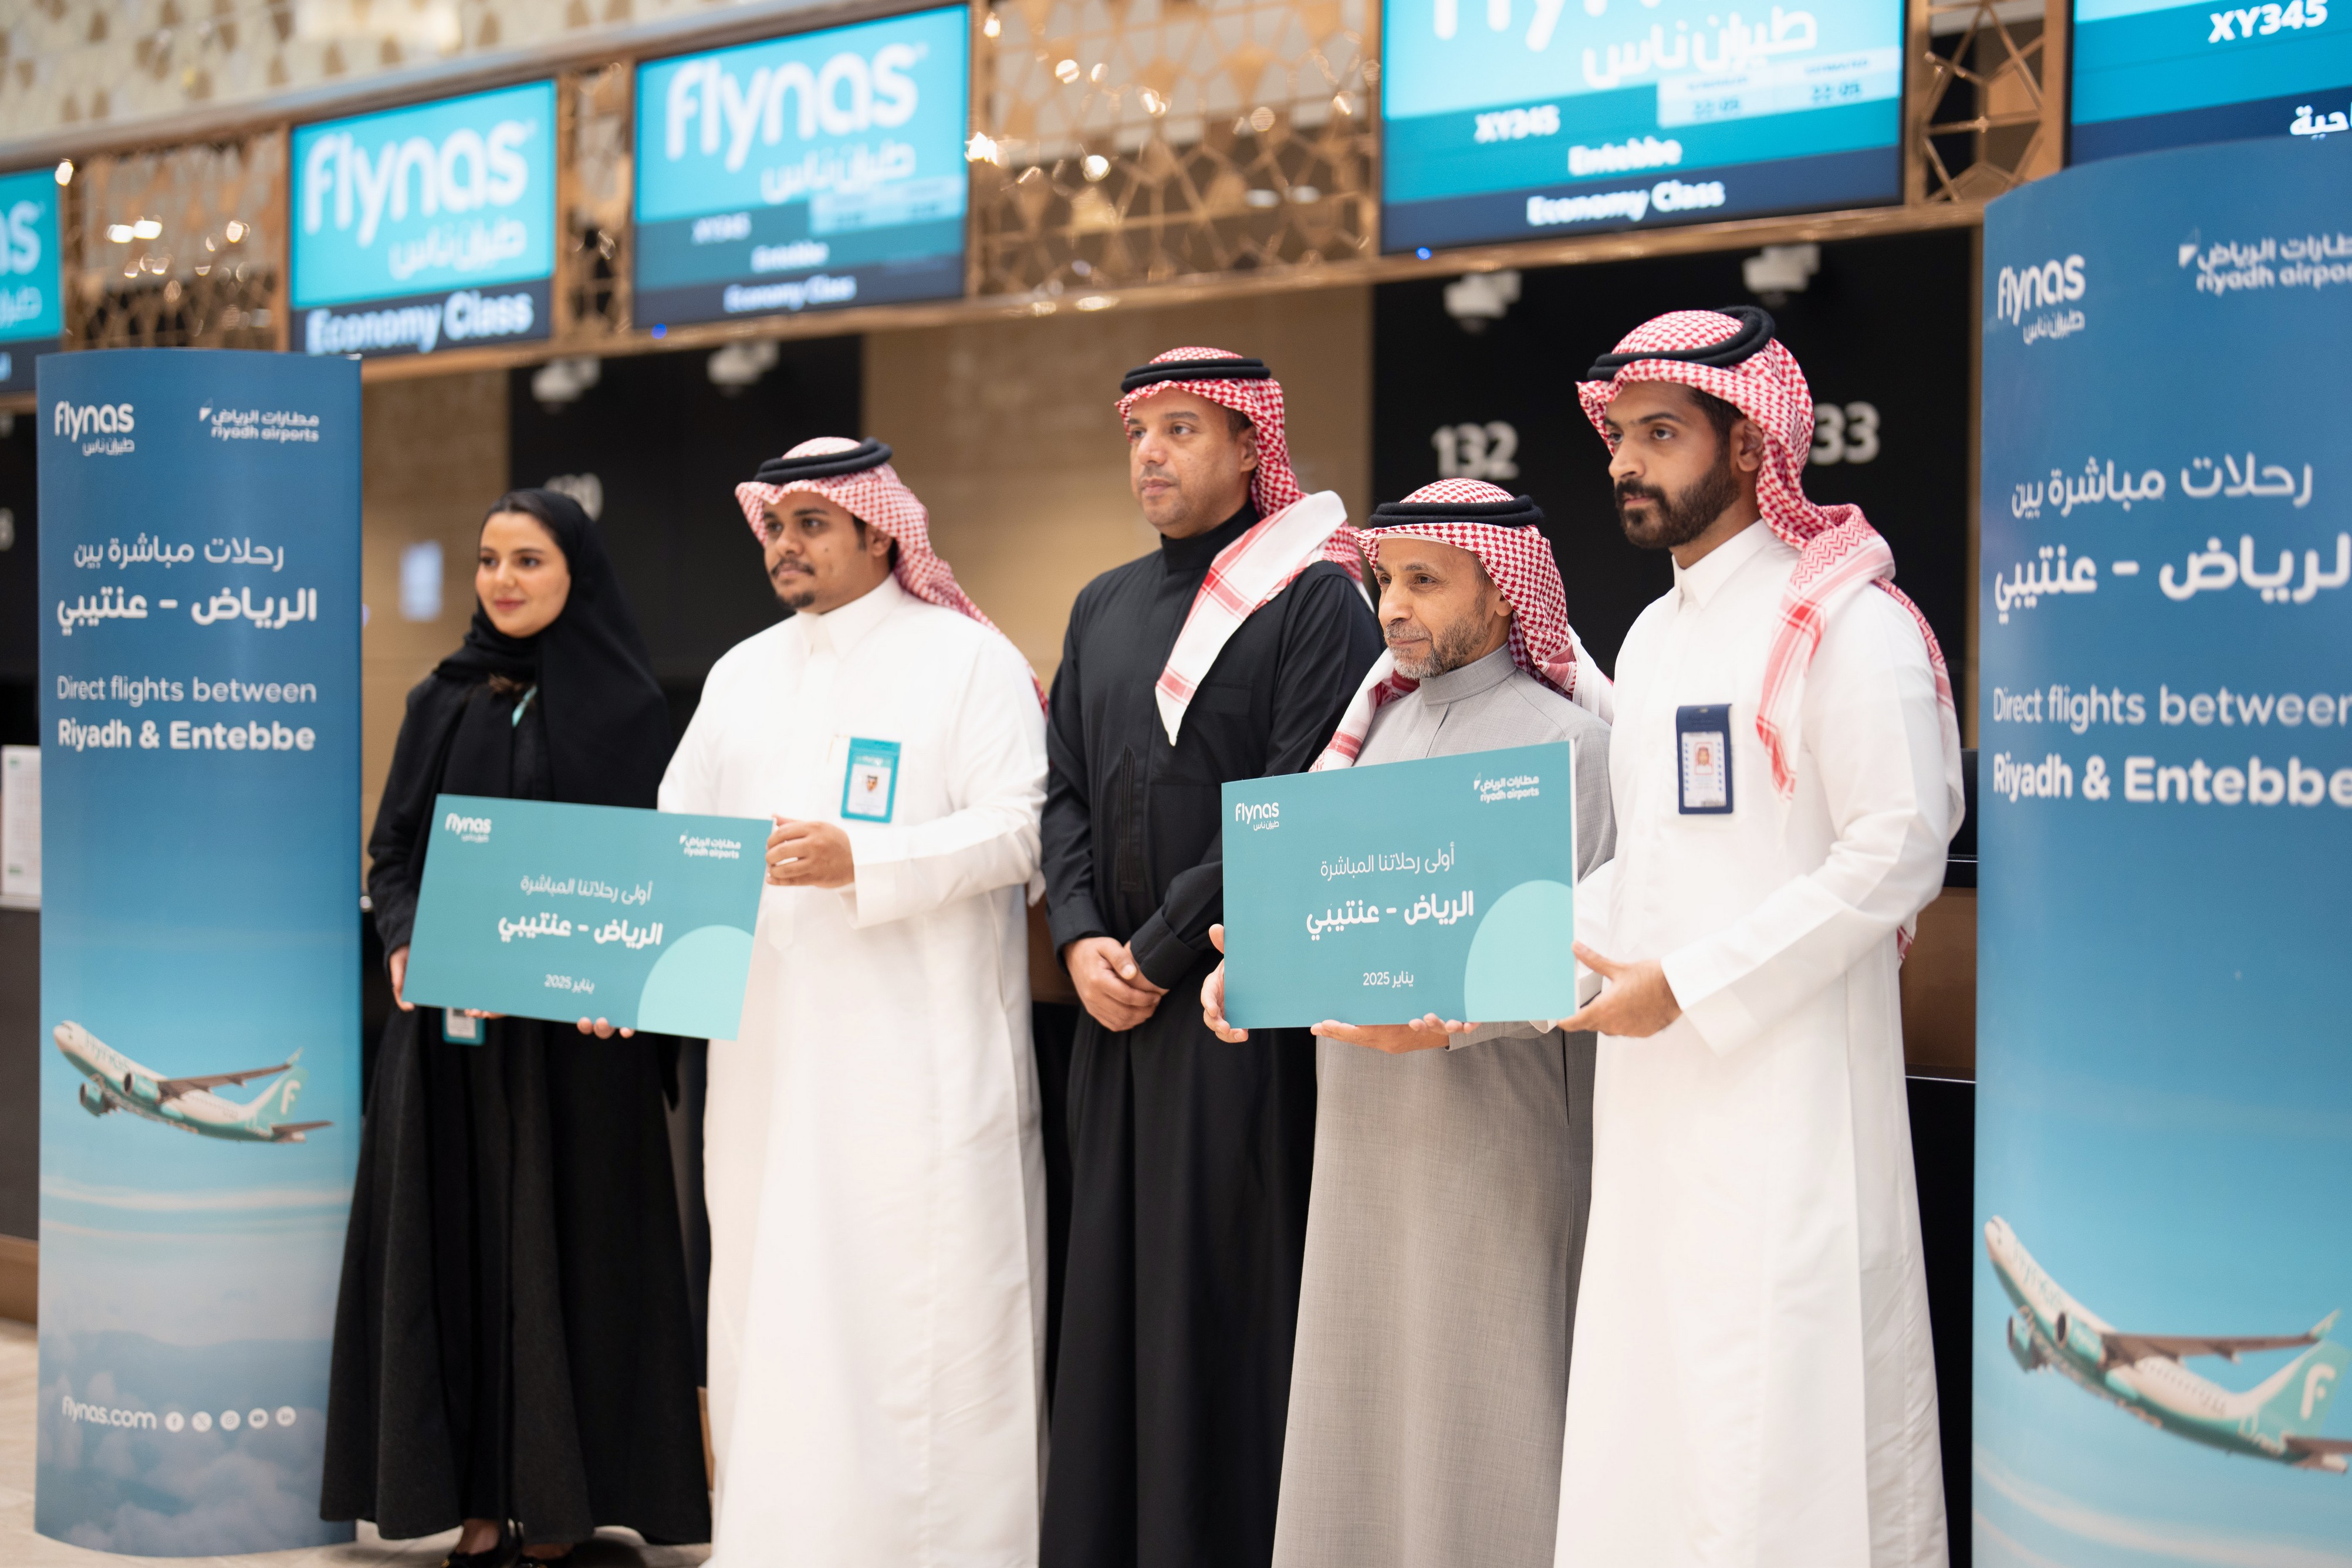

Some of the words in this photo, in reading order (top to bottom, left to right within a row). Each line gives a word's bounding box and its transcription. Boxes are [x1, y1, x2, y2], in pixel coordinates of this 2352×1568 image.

[1692, 4, 1817, 73] طيران
[2208, 0, 2328, 43] XY345
[1581, 19, 1688, 89] ناس
[665, 44, 917, 173] flynas
[1474, 104, 1560, 144] XY345
[1568, 136, 1682, 177] Entebbe
[305, 120, 527, 249] flynas
[1527, 189, 1650, 226] Economy
[1650, 178, 1726, 213] Class
[1998, 254, 2085, 326] flynas
[2196, 263, 2275, 297] riyadh
[306, 305, 442, 356] Economy
[443, 290, 534, 340] Class
[55, 401, 134, 442] flynas
[211, 408, 259, 426] الرياض
[211, 425, 259, 441] riyadh
[261, 427, 319, 443] airports
[262, 410, 319, 427] مطارات
[1810, 402, 1880, 465] 33
[1431, 421, 1519, 480] 132
[2048, 456, 2166, 517] مباشرة
[2181, 451, 2312, 508] رحلات
[2012, 481, 2043, 519] بين
[74, 543, 103, 569] بين
[108, 532, 195, 569] مباشرة
[204, 537, 284, 572] رحلات
[1995, 543, 2097, 624] عنتيبي
[2159, 532, 2352, 604] لرياض
[58, 586, 148, 636] عنتيبي
[191, 586, 317, 630] الرياض
[58, 675, 105, 701] Direct
[111, 675, 184, 707] flights
[193, 677, 317, 703] between
[1993, 686, 2043, 723] Direct
[2049, 683, 2146, 735] flights
[58, 718, 132, 752] Riyadh
[138, 721, 160, 749] &
[170, 721, 316, 751] Entebbe
[1480, 778, 1506, 792] الرياض
[1506, 775, 1539, 788] مطارات
[1993, 751, 2073, 803] Riyadh
[2081, 755, 2111, 802] &
[1480, 790, 1506, 804] riyadh
[1506, 786, 1539, 800] airports
[445, 812, 492, 836] flynas
[1235, 802, 1279, 824] flynas
[1253, 821, 1265, 831] ناس
[1266, 820, 1279, 830] طيران
[684, 847, 708, 857] riyadh
[709, 848, 739, 860] airports
[1320, 854, 1374, 881] المباشرة
[1378, 851, 1420, 874] رحلاتنا
[1425, 841, 1455, 873] أولى
[521, 874, 575, 897] المباشرة
[577, 878, 619, 903] رحلاتنا
[621, 880, 653, 905] أولى
[1307, 900, 1379, 941] عنتيبي
[1404, 890, 1474, 925] الرياض
[498, 912, 572, 943] عنتيبي
[594, 919, 663, 949] الرياض
[544, 974, 572, 989] 2025
[572, 978, 595, 995] يناير
[1363, 972, 1390, 985] 2025
[1392, 971, 1414, 988] يناير
[62, 1395, 157, 1430] flynas.com
